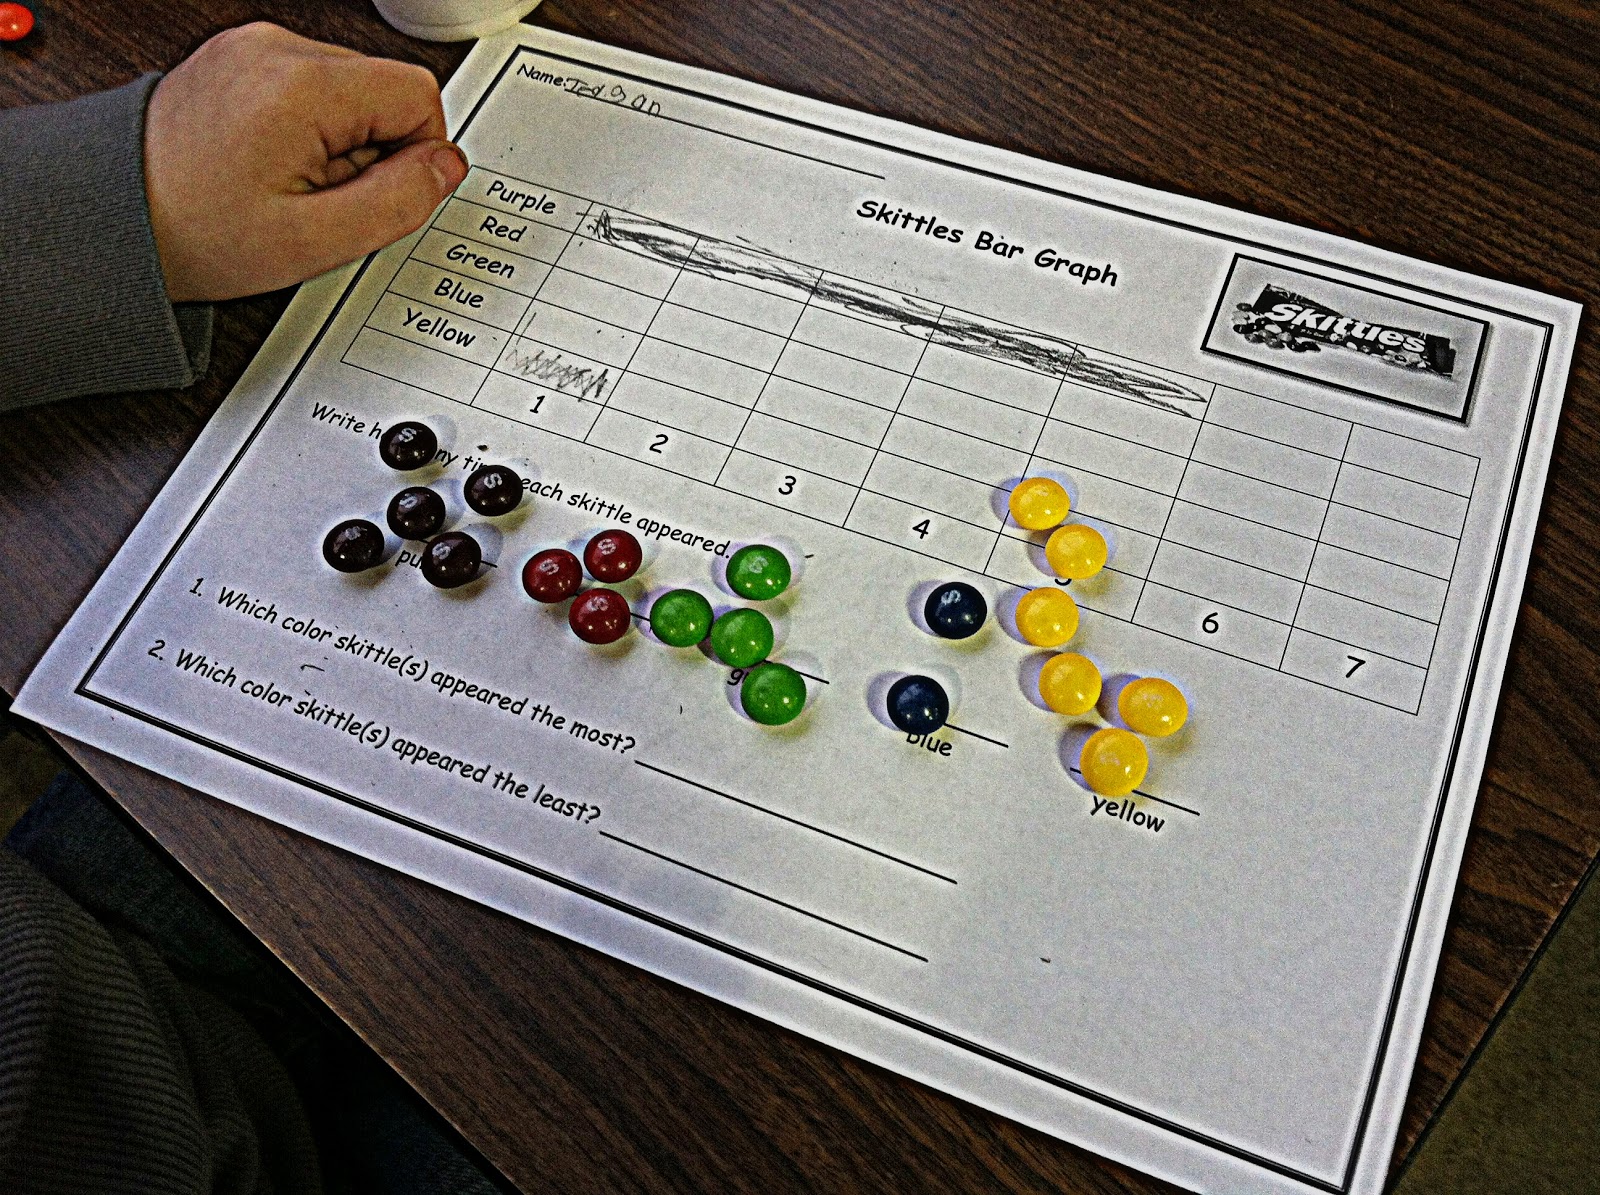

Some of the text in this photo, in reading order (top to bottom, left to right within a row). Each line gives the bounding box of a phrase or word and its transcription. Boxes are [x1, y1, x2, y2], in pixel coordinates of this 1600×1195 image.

[516, 63, 567, 87] Name:
[486, 180, 556, 215] Purple
[479, 215, 527, 242] Red
[856, 200, 1119, 287] Skittles Bar Graph
[446, 243, 515, 279] Green
[434, 277, 484, 308] Blue
[402, 307, 476, 347] Yellow
[1264, 303, 1426, 353] Skittles
[312, 402, 366, 433] Write
[434, 448, 459, 468] ny
[521, 478, 563, 502] each
[567, 492, 632, 525] skittle
[636, 517, 731, 559] appeared.
[529, 395, 1366, 679] 1 2 3 4 6 7
[188, 577, 636, 754] 1. Which color skittle(s) appeared the most?
[147, 639, 602, 825] 2. Which color skittle(s) appeared the least?
[1089, 795, 1166, 833] yellow
